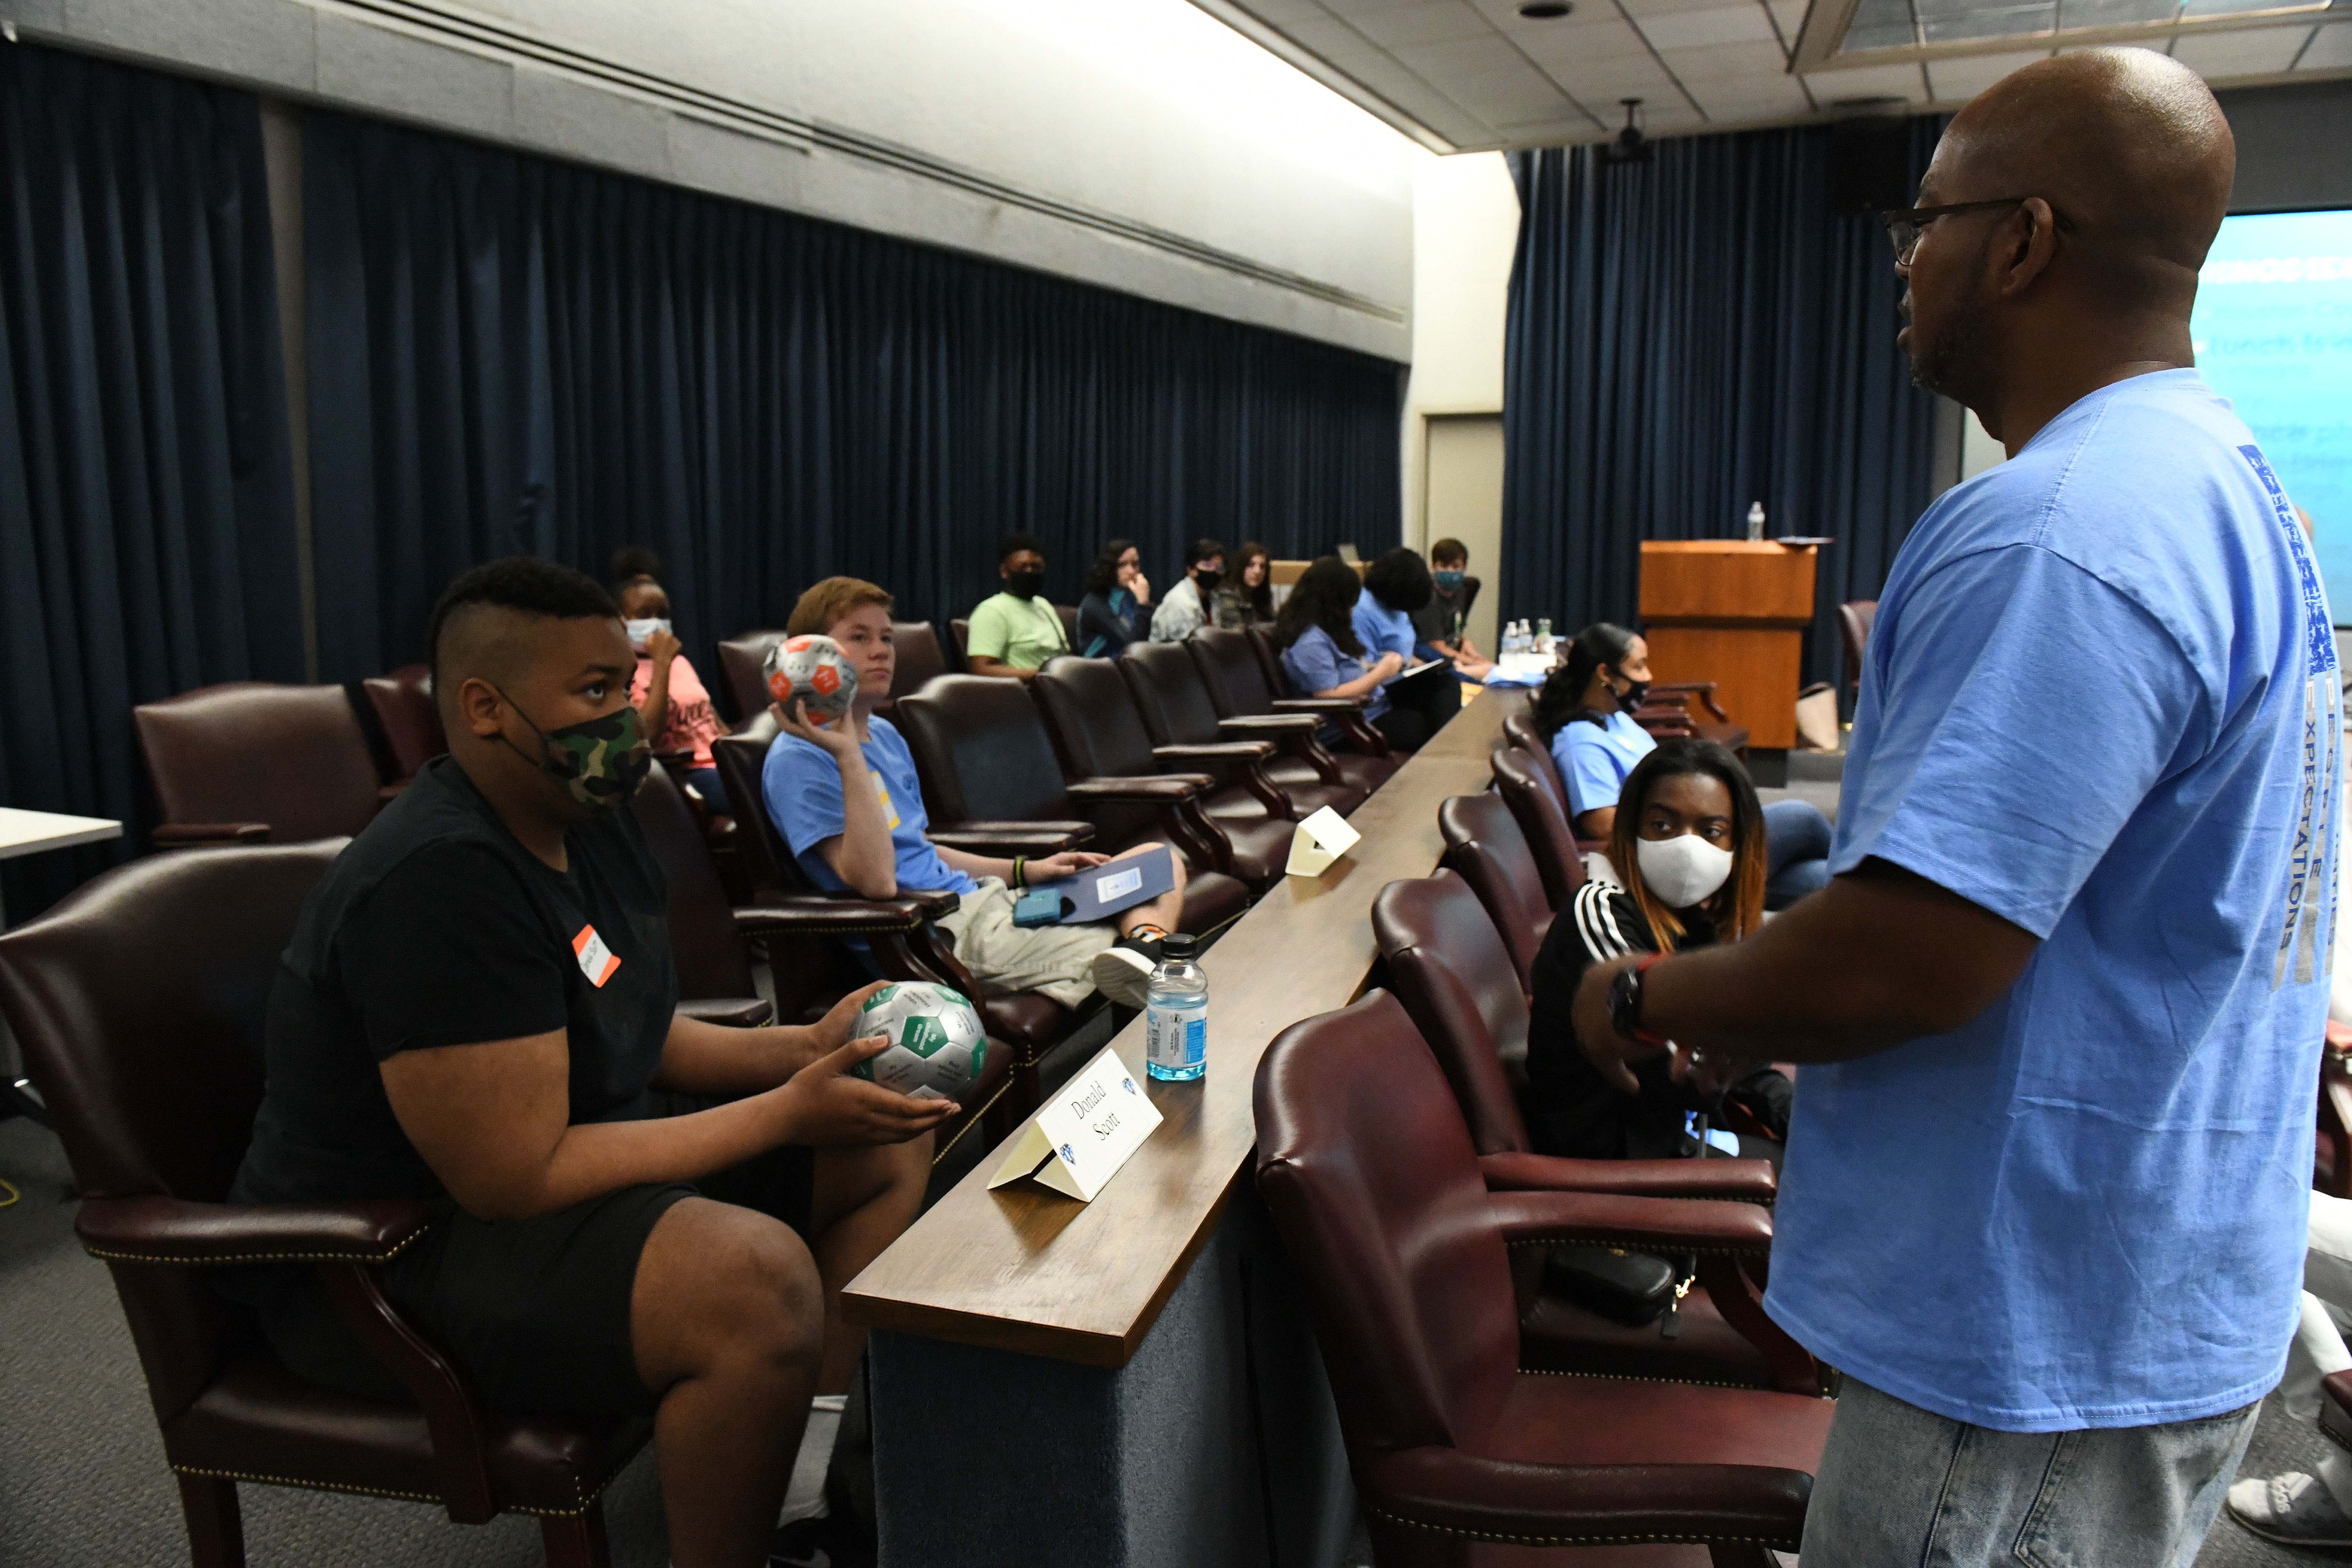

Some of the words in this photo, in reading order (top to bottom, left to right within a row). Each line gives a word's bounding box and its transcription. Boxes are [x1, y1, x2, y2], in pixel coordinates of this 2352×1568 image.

[2280, 680, 2316, 949] EXPECTATIONS
[1071, 1081, 1106, 1119] Donald
[1093, 1111, 1120, 1140] Scott
